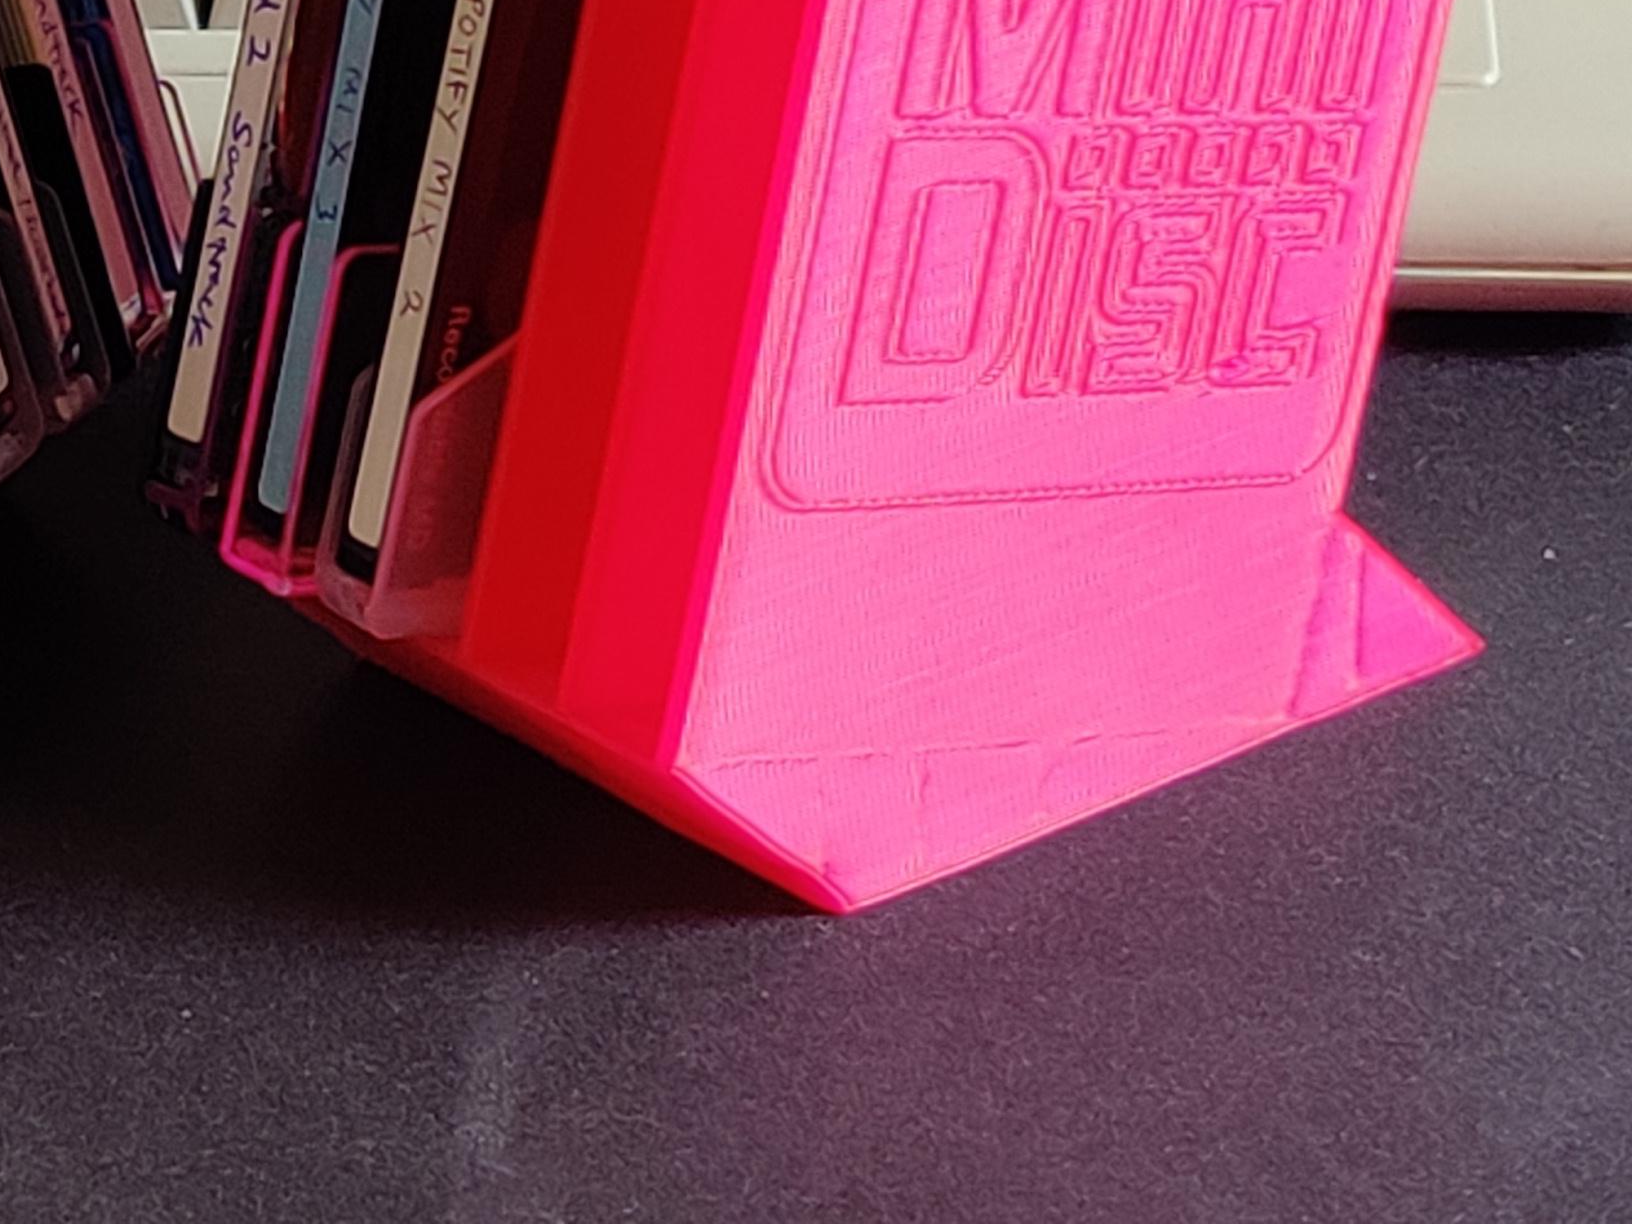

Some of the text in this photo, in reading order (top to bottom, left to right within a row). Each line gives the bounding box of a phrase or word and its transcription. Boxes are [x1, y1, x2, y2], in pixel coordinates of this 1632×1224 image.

[246, 36, 272, 68] 2
[326, 67, 363, 169] MIX
[411, 158, 452, 244] MIX
[400, 288, 423, 319] 2
